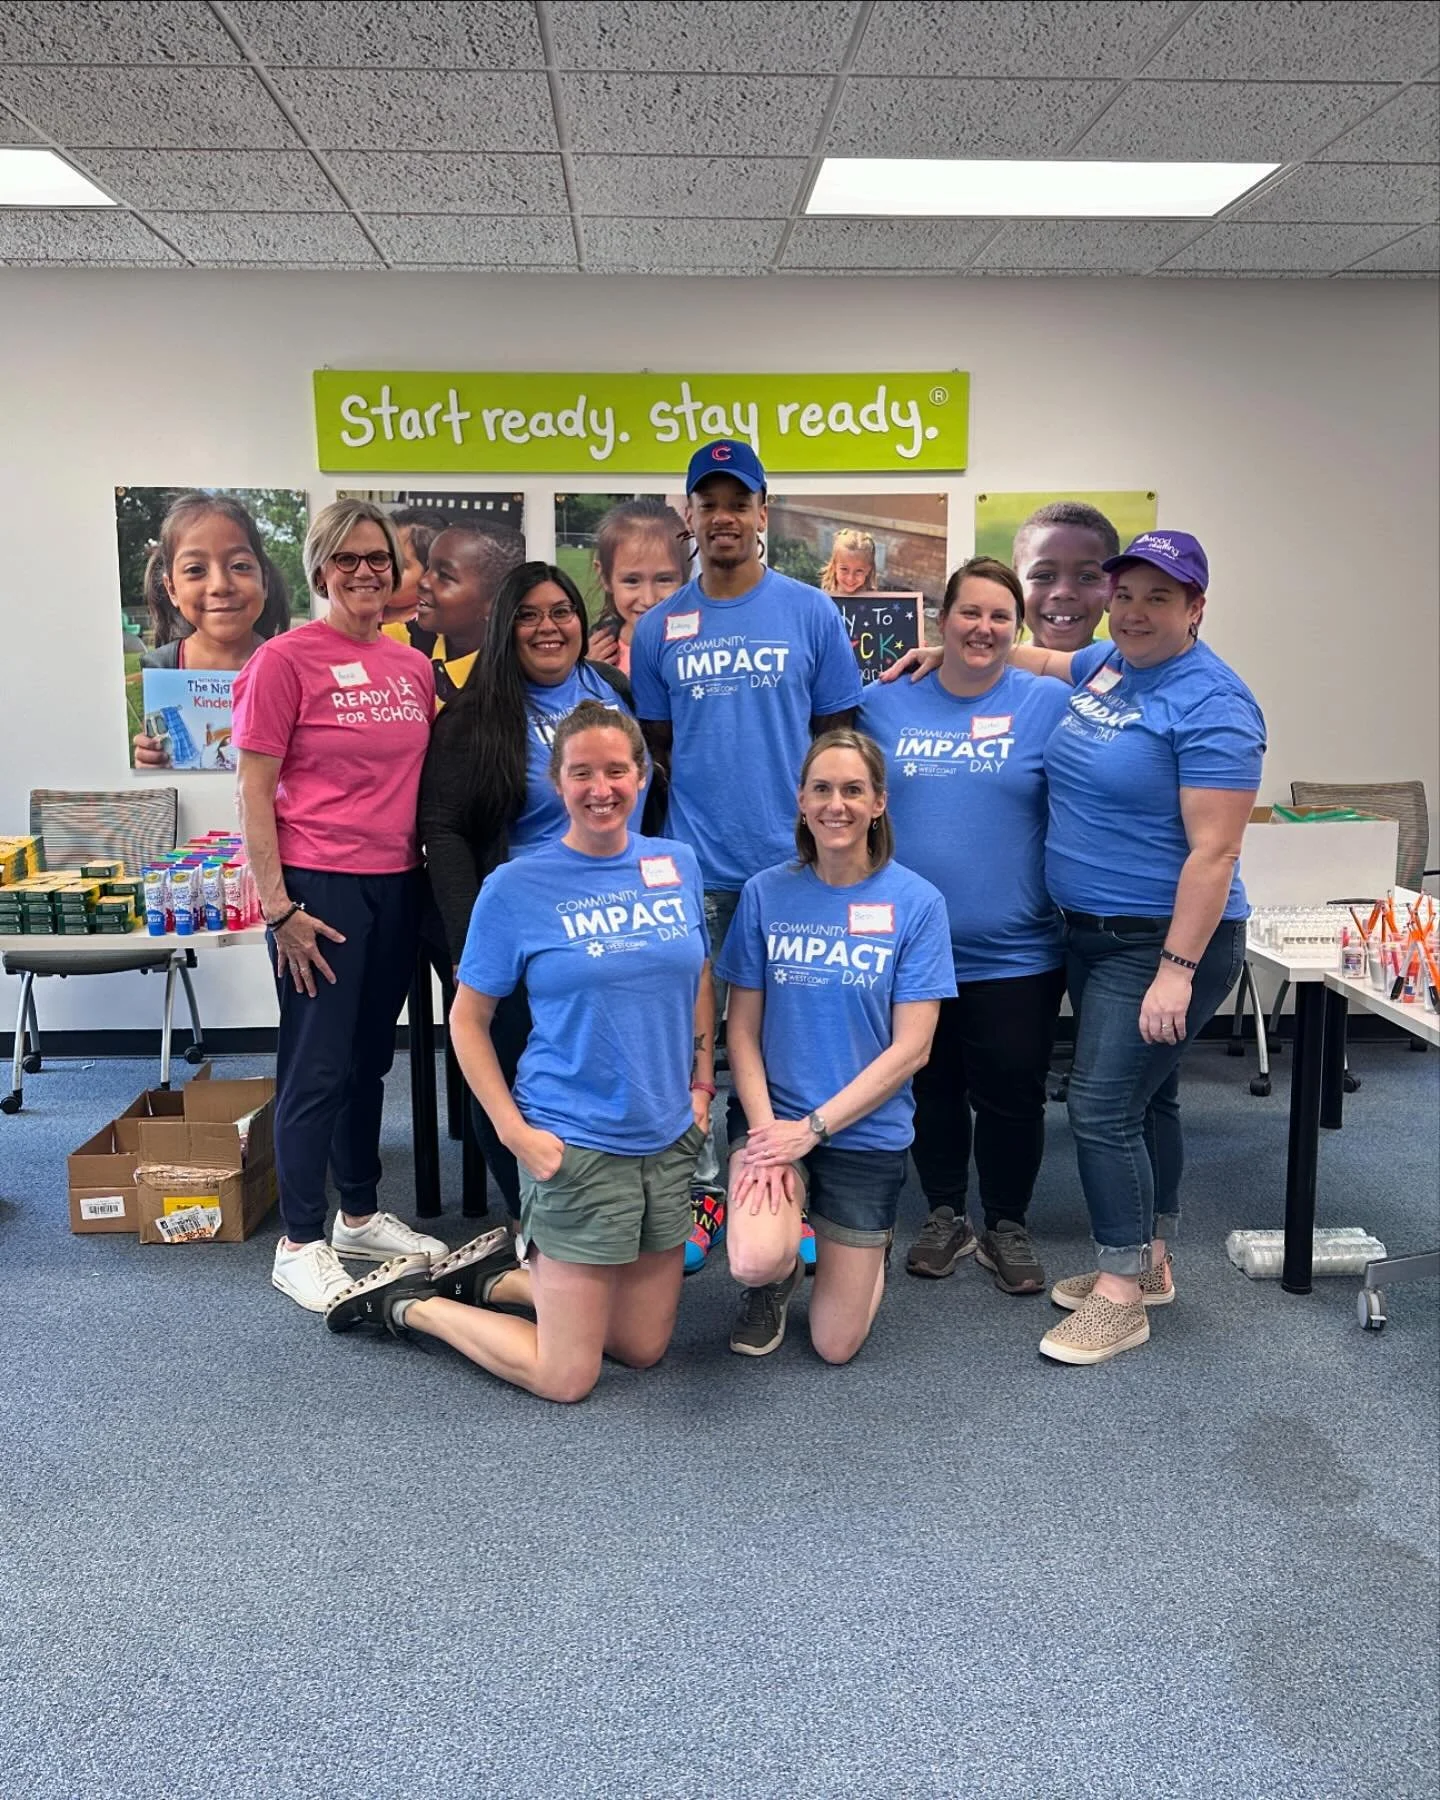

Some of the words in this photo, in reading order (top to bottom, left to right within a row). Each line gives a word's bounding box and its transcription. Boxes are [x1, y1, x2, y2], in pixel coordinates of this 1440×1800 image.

[341, 386, 470, 447] Start
[482, 395, 630, 460] ready.
[649, 382, 760, 458] stay
[778, 385, 938, 458] ready.
[711, 445, 732, 461] C
[872, 607, 893, 626] To
[676, 635, 747, 655] COMMUNITY
[677, 647, 790, 680] IMPACT
[187, 679, 208, 692] The
[211, 683, 230, 695] Nig
[751, 674, 782, 688] DAY
[193, 695, 232, 709] Kinder
[331, 690, 391, 709] READY
[336, 711, 368, 725] FOR
[900, 726, 971, 740] COMMUNITY
[1094, 726, 1121, 743] DAY
[895, 738, 1015, 759] IMPACT
[969, 759, 1005, 774] DAY
[556, 889, 639, 914] COMMUNITY
[561, 897, 688, 939] IMPACT
[657, 923, 690, 942] DAY
[769, 921, 848, 937] COMMUNITY
[767, 934, 893, 974] IMPACT
[841, 969, 879, 990] DAY
[455, 1283, 462, 1295] DC
